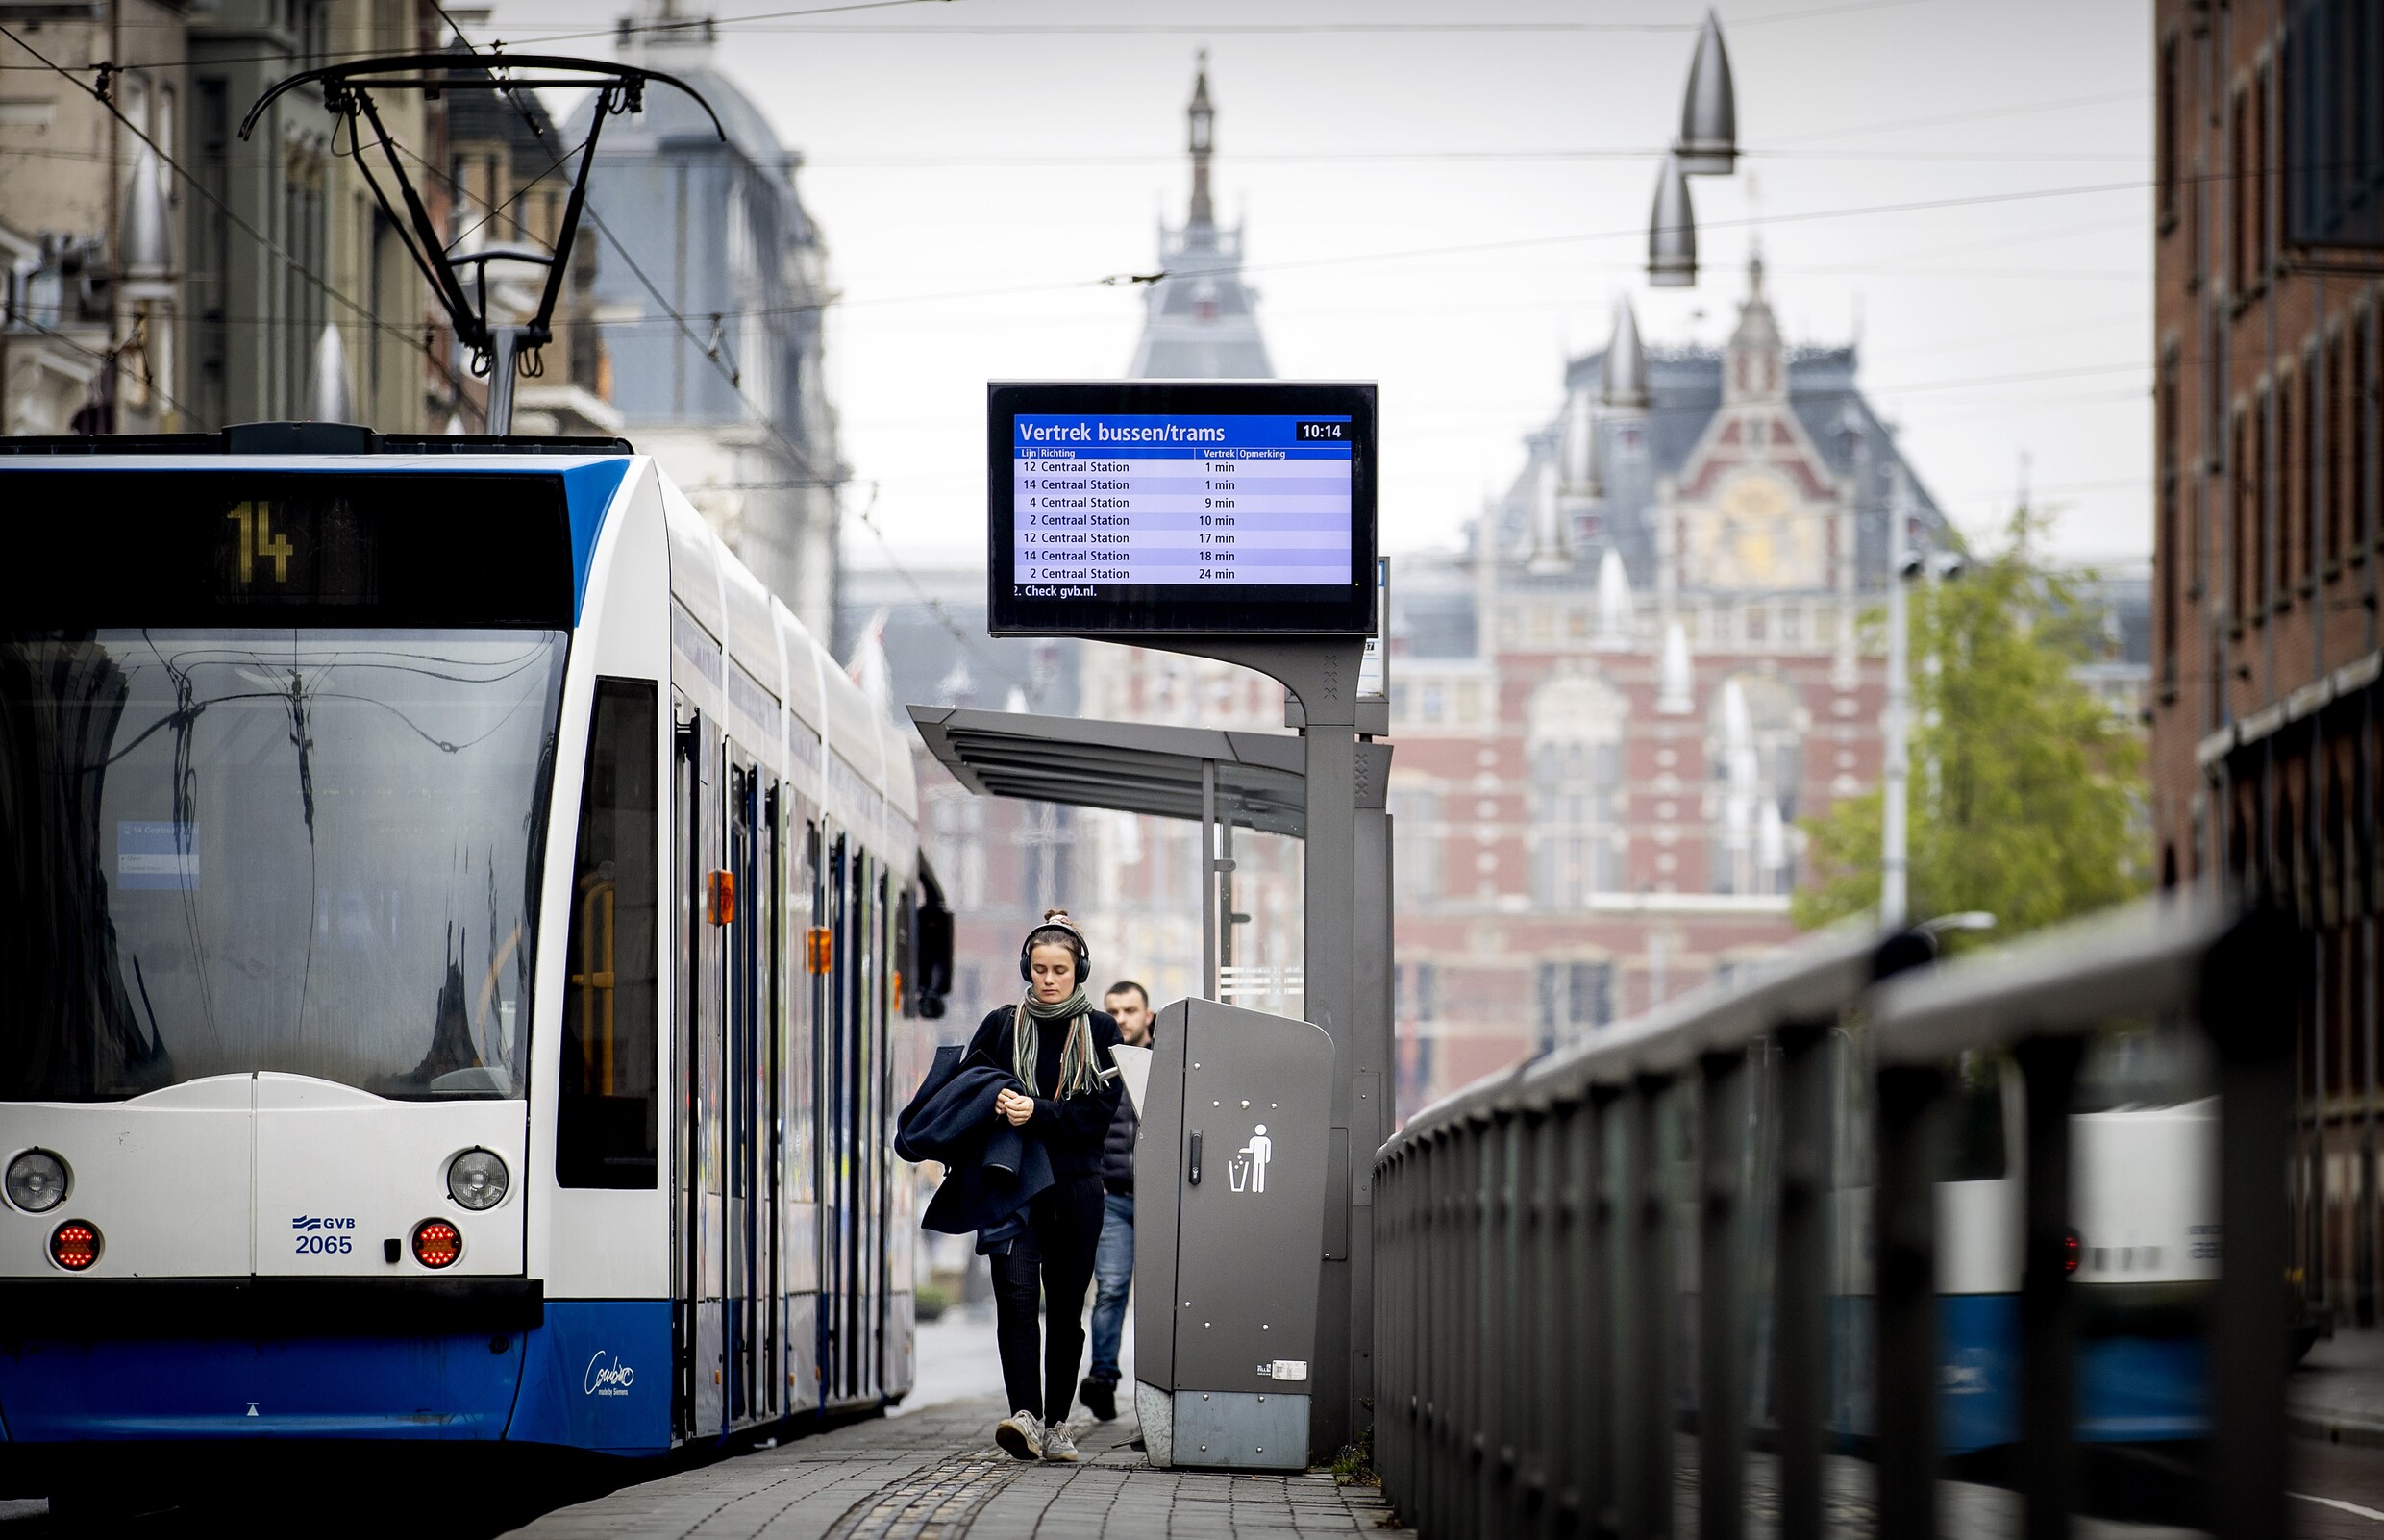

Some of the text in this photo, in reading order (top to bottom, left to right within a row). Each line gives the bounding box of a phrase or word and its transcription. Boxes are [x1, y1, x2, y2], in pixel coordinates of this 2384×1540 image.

[1020, 423, 1226, 442] Vertrek bussen/trams
[1303, 424, 1342, 438] 10:14
[1021, 449, 1286, 460] Lijn Richting Vertrek Opmerking
[1024, 461, 1235, 472] 12 Centraal Station 1 min
[1024, 479, 1235, 489] 14 Centraal Station 1 min
[1030, 497, 1235, 508] 4 Centraal Station 9 min
[1030, 514, 1235, 525] 2 Centraal Station 10 min
[227, 500, 293, 583] 14
[1024, 533, 1235, 543] 12 Centraal Station 17 min
[1024, 550, 1235, 560] 14 Centraal Station 18 min
[1030, 568, 1235, 579] 2 Centraal Station 24 min
[1025, 584, 1057, 596] Check
[1060, 584, 1098, 599] gvb.nl.
[323, 1217, 356, 1229] GVB
[295, 1235, 352, 1254] 2065
